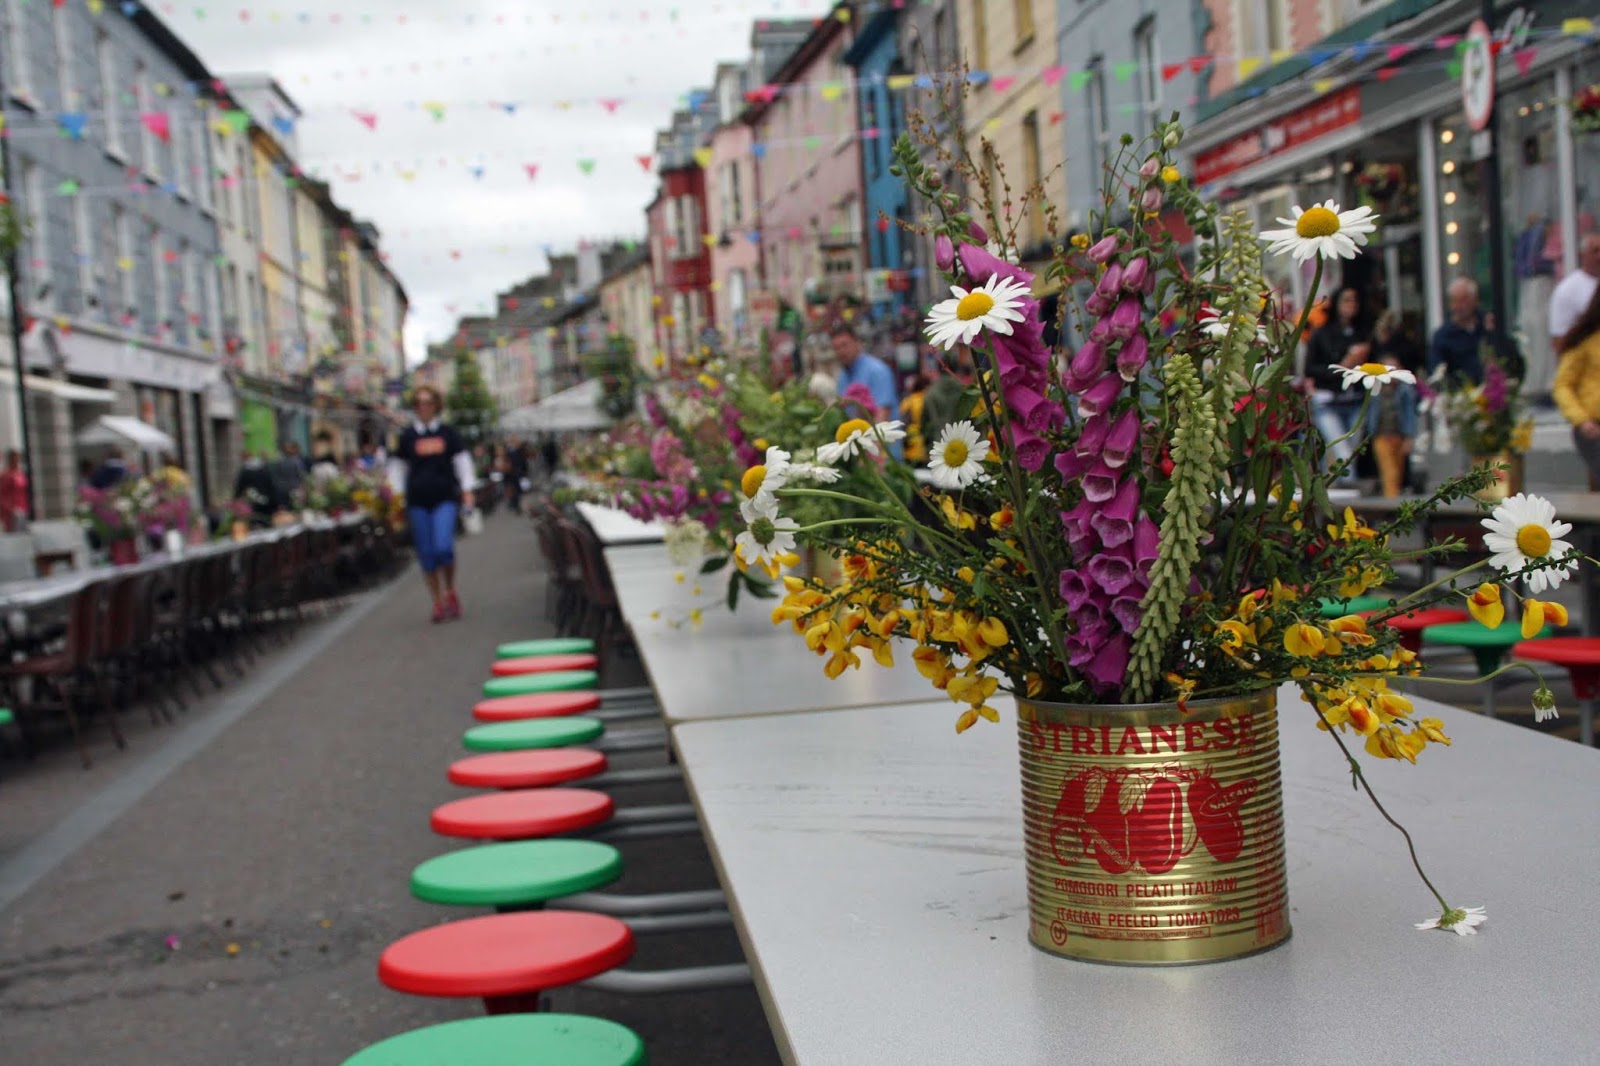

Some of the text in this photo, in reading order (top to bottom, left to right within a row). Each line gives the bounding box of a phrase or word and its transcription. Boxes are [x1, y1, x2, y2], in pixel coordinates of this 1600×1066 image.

[1030, 713, 1256, 756] STRIANESE
[1055, 878, 1119, 897] POMODORI
[1126, 883, 1174, 898] PELATI
[1057, 907, 1101, 925] ITALIAN
[1108, 913, 1159, 928] PEELED
[1167, 907, 1241, 927] TOMATOES
